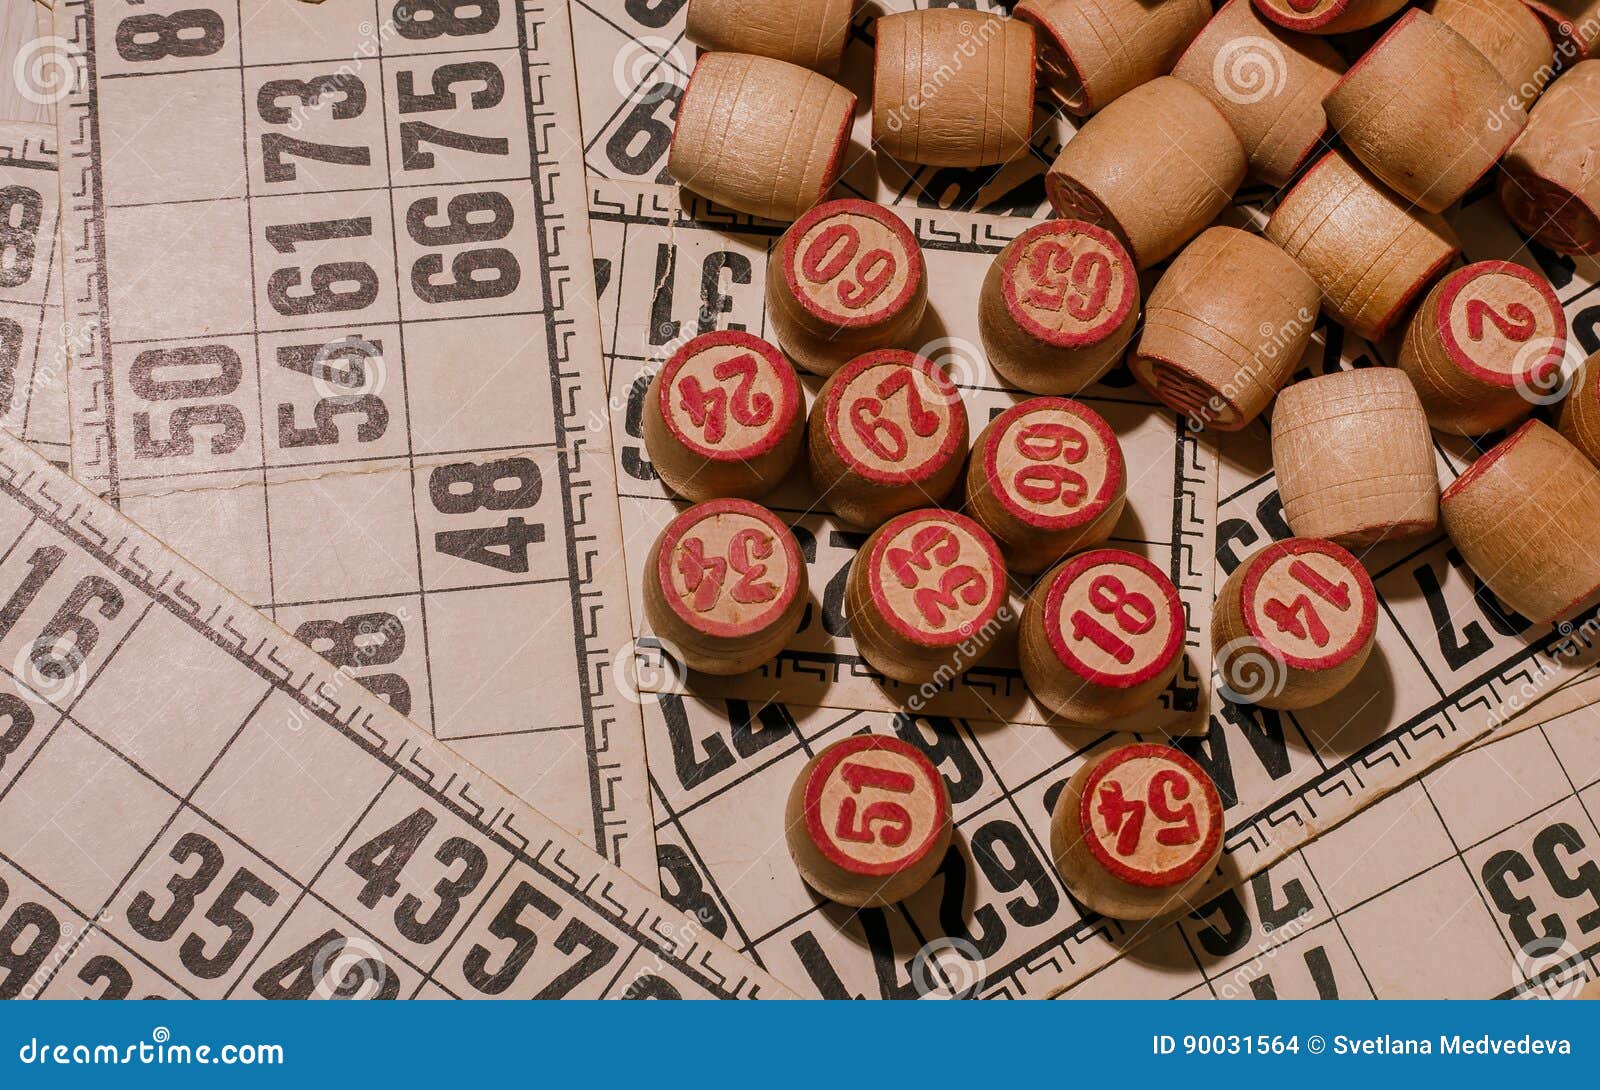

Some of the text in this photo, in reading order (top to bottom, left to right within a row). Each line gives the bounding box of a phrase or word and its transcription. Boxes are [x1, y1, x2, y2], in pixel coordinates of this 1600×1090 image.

[257, 73, 371, 183] 73
[396, 60, 509, 171] 75
[265, 216, 379, 316] 61
[1467, 299, 1537, 343] 2
[128, 344, 246, 461] 50
[276, 334, 390, 450] 54
[678, 354, 773, 444] 24
[429, 457, 546, 573] 48
[676, 528, 779, 612] 34
[887, 525, 987, 627] 33
[1069, 575, 1157, 665] 18
[1262, 560, 1351, 648] 14
[835, 761, 915, 847] 51
[1098, 769, 1200, 857] 54
[126, 832, 280, 979] 35
[344, 807, 488, 944] 43
[936, 819, 1060, 961] 62
[1482, 822, 1600, 958] 53
[462, 881, 618, 995] 57
